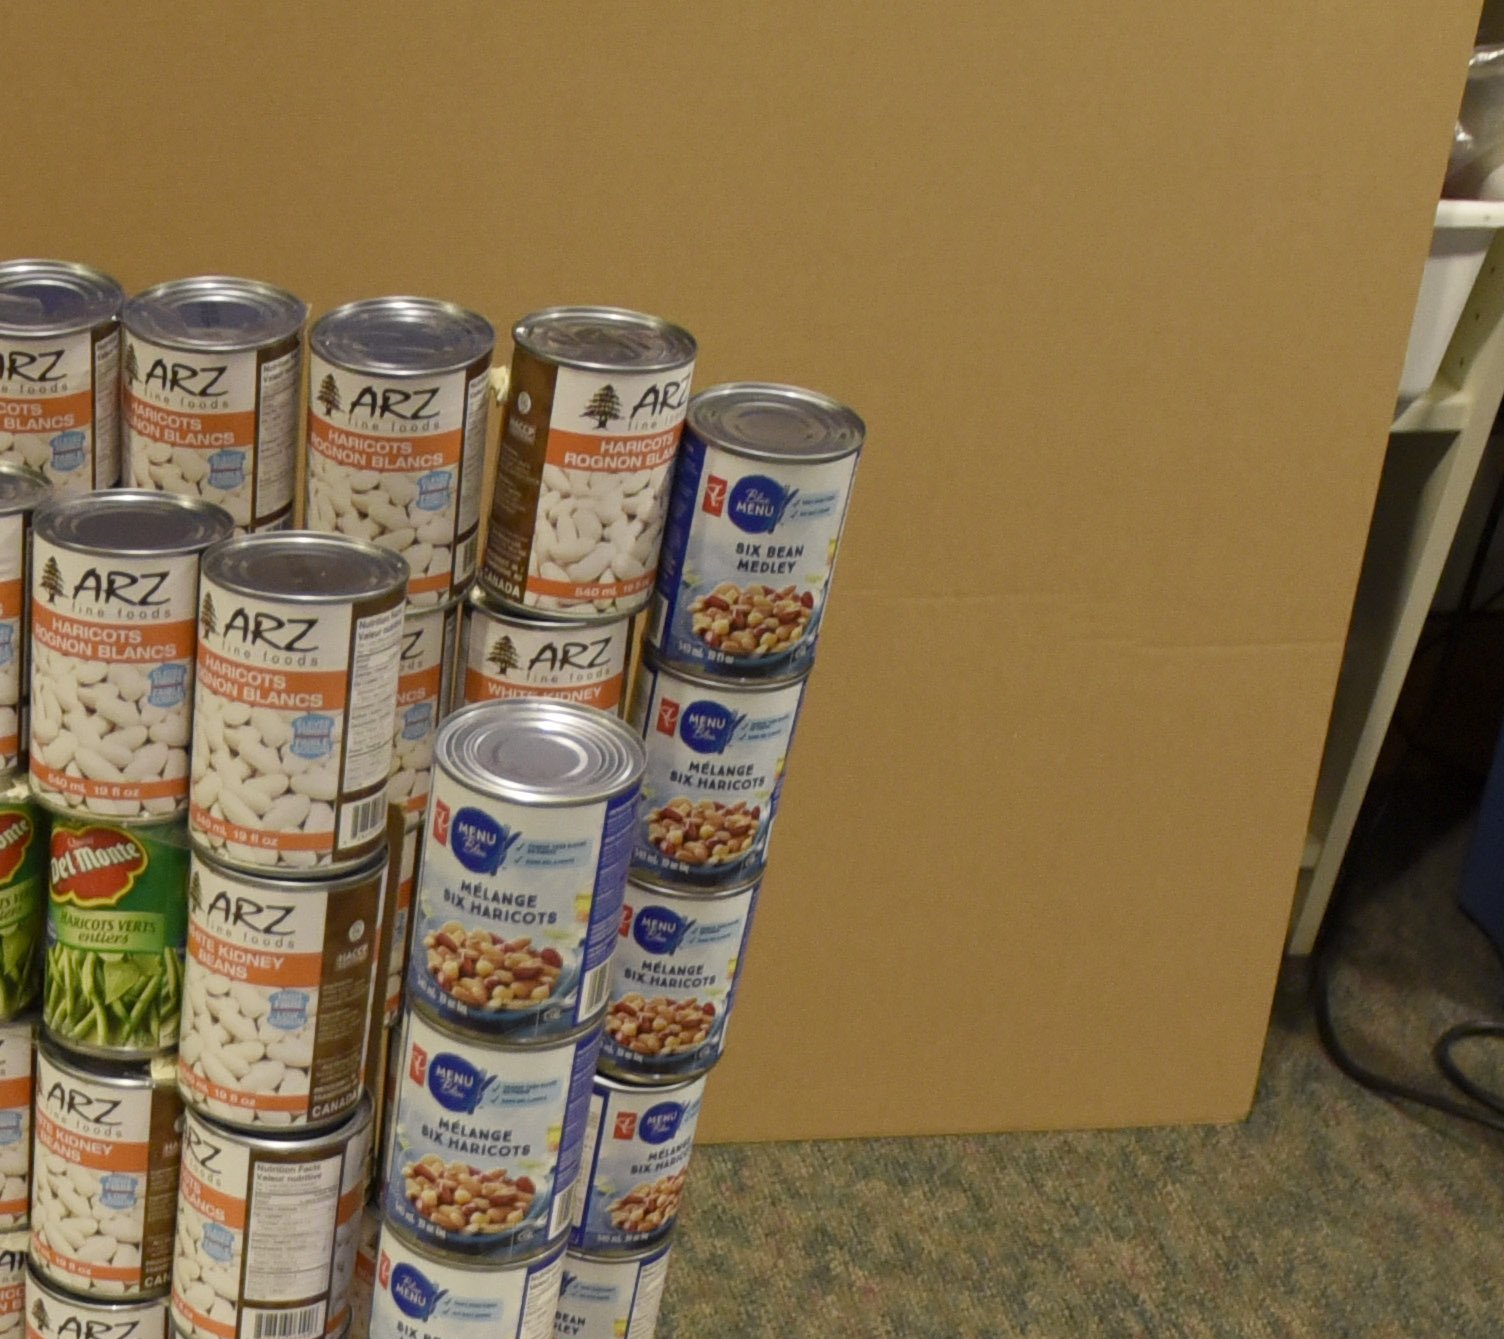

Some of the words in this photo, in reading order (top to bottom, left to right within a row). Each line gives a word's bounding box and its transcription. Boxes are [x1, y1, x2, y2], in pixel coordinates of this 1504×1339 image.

[145, 357, 229, 398] ARZ
[348, 386, 440, 420] ARZ
[164, 430, 234, 445] BLANCS
[329, 430, 412, 454] HARICOTS
[564, 450, 642, 468] ROGNON
[736, 501, 774, 517] MENU
[736, 542, 762, 557] SIX
[768, 544, 804, 558] BEAN
[737, 560, 797, 575] MEDLEY
[72, 568, 171, 605] ARZ
[52, 619, 141, 644] HARICOTS
[223, 609, 319, 652] ARZ
[527, 637, 613, 674] ARZ
[206, 655, 286, 690] HARICOTS
[244, 686, 323, 707] BLANCS
[690, 713, 726, 730] MENU
[688, 760, 755, 777] MÉLANGE
[457, 822, 497, 846] MENU
[51, 857, 76, 882] Del
[77, 841, 138, 868] Monte
[459, 879, 537, 908] MÉLANGE
[208, 891, 296, 935] ARZ
[221, 944, 284, 969] KIDNEY
[641, 960, 704, 976] MÉLANGE
[434, 1065, 474, 1089] MENU
[47, 1083, 122, 1126] ARZ
[438, 1116, 513, 1143] MÉLANGE
